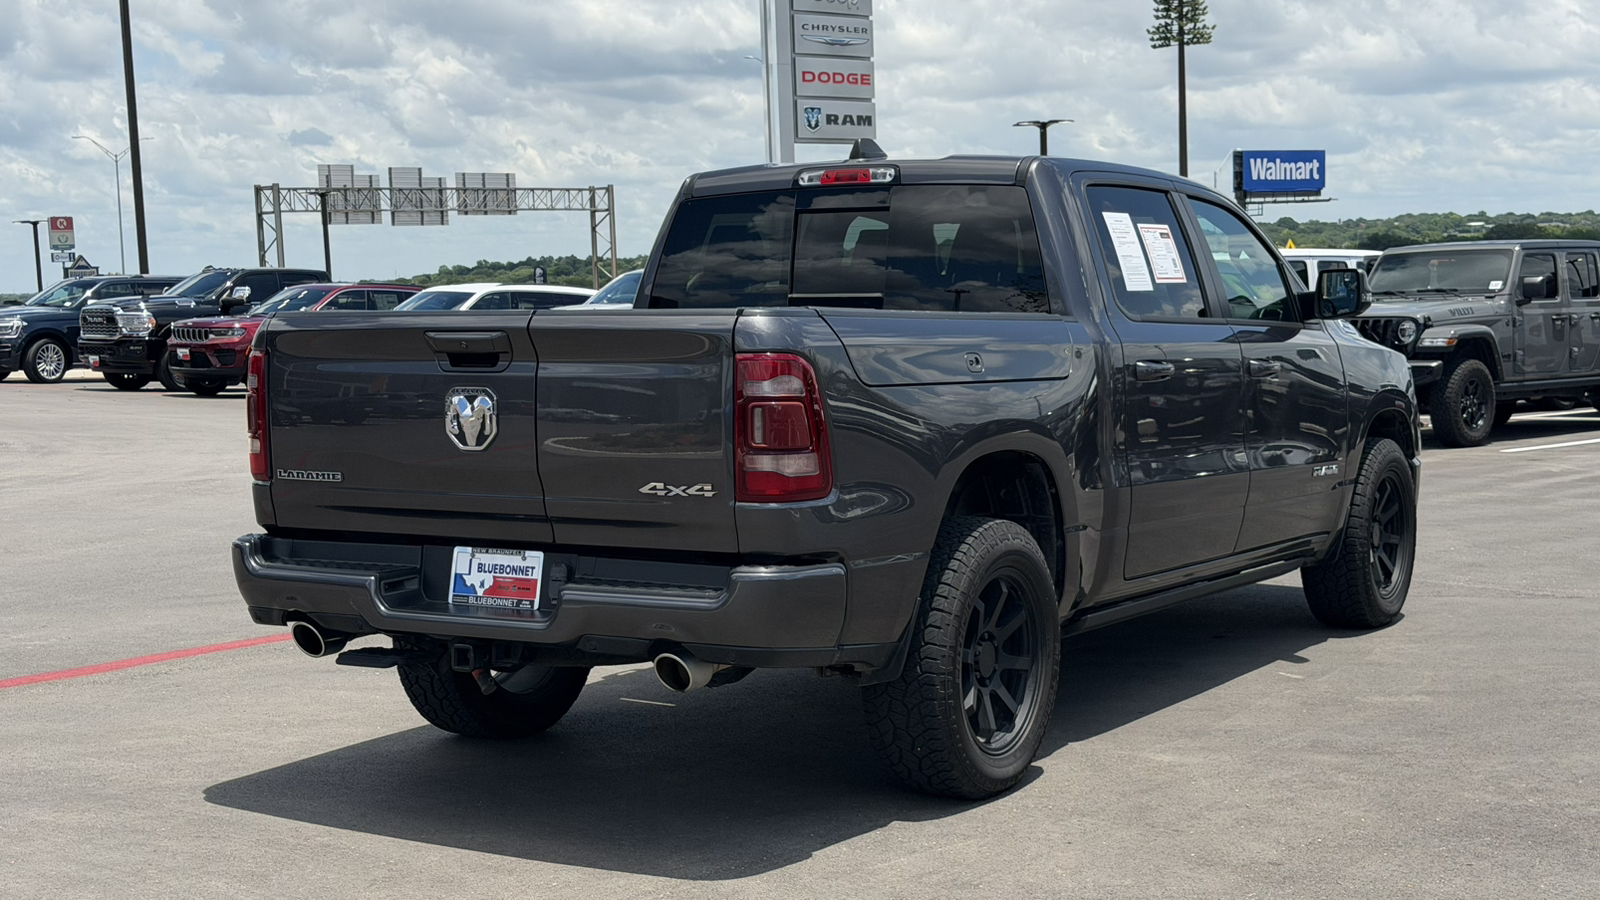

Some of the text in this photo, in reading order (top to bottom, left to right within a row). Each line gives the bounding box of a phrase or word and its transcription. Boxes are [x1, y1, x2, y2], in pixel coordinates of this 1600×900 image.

[801, 23, 868, 34] CHRYSLER
[801, 71, 871, 86] DODGE
[825, 113, 872, 127] RAM
[1249, 157, 1320, 181] Walmart
[277, 469, 343, 482] LARAMIE
[477, 562, 536, 577] BLUEBONNET
[468, 596, 518, 607] BLUEBONNET
